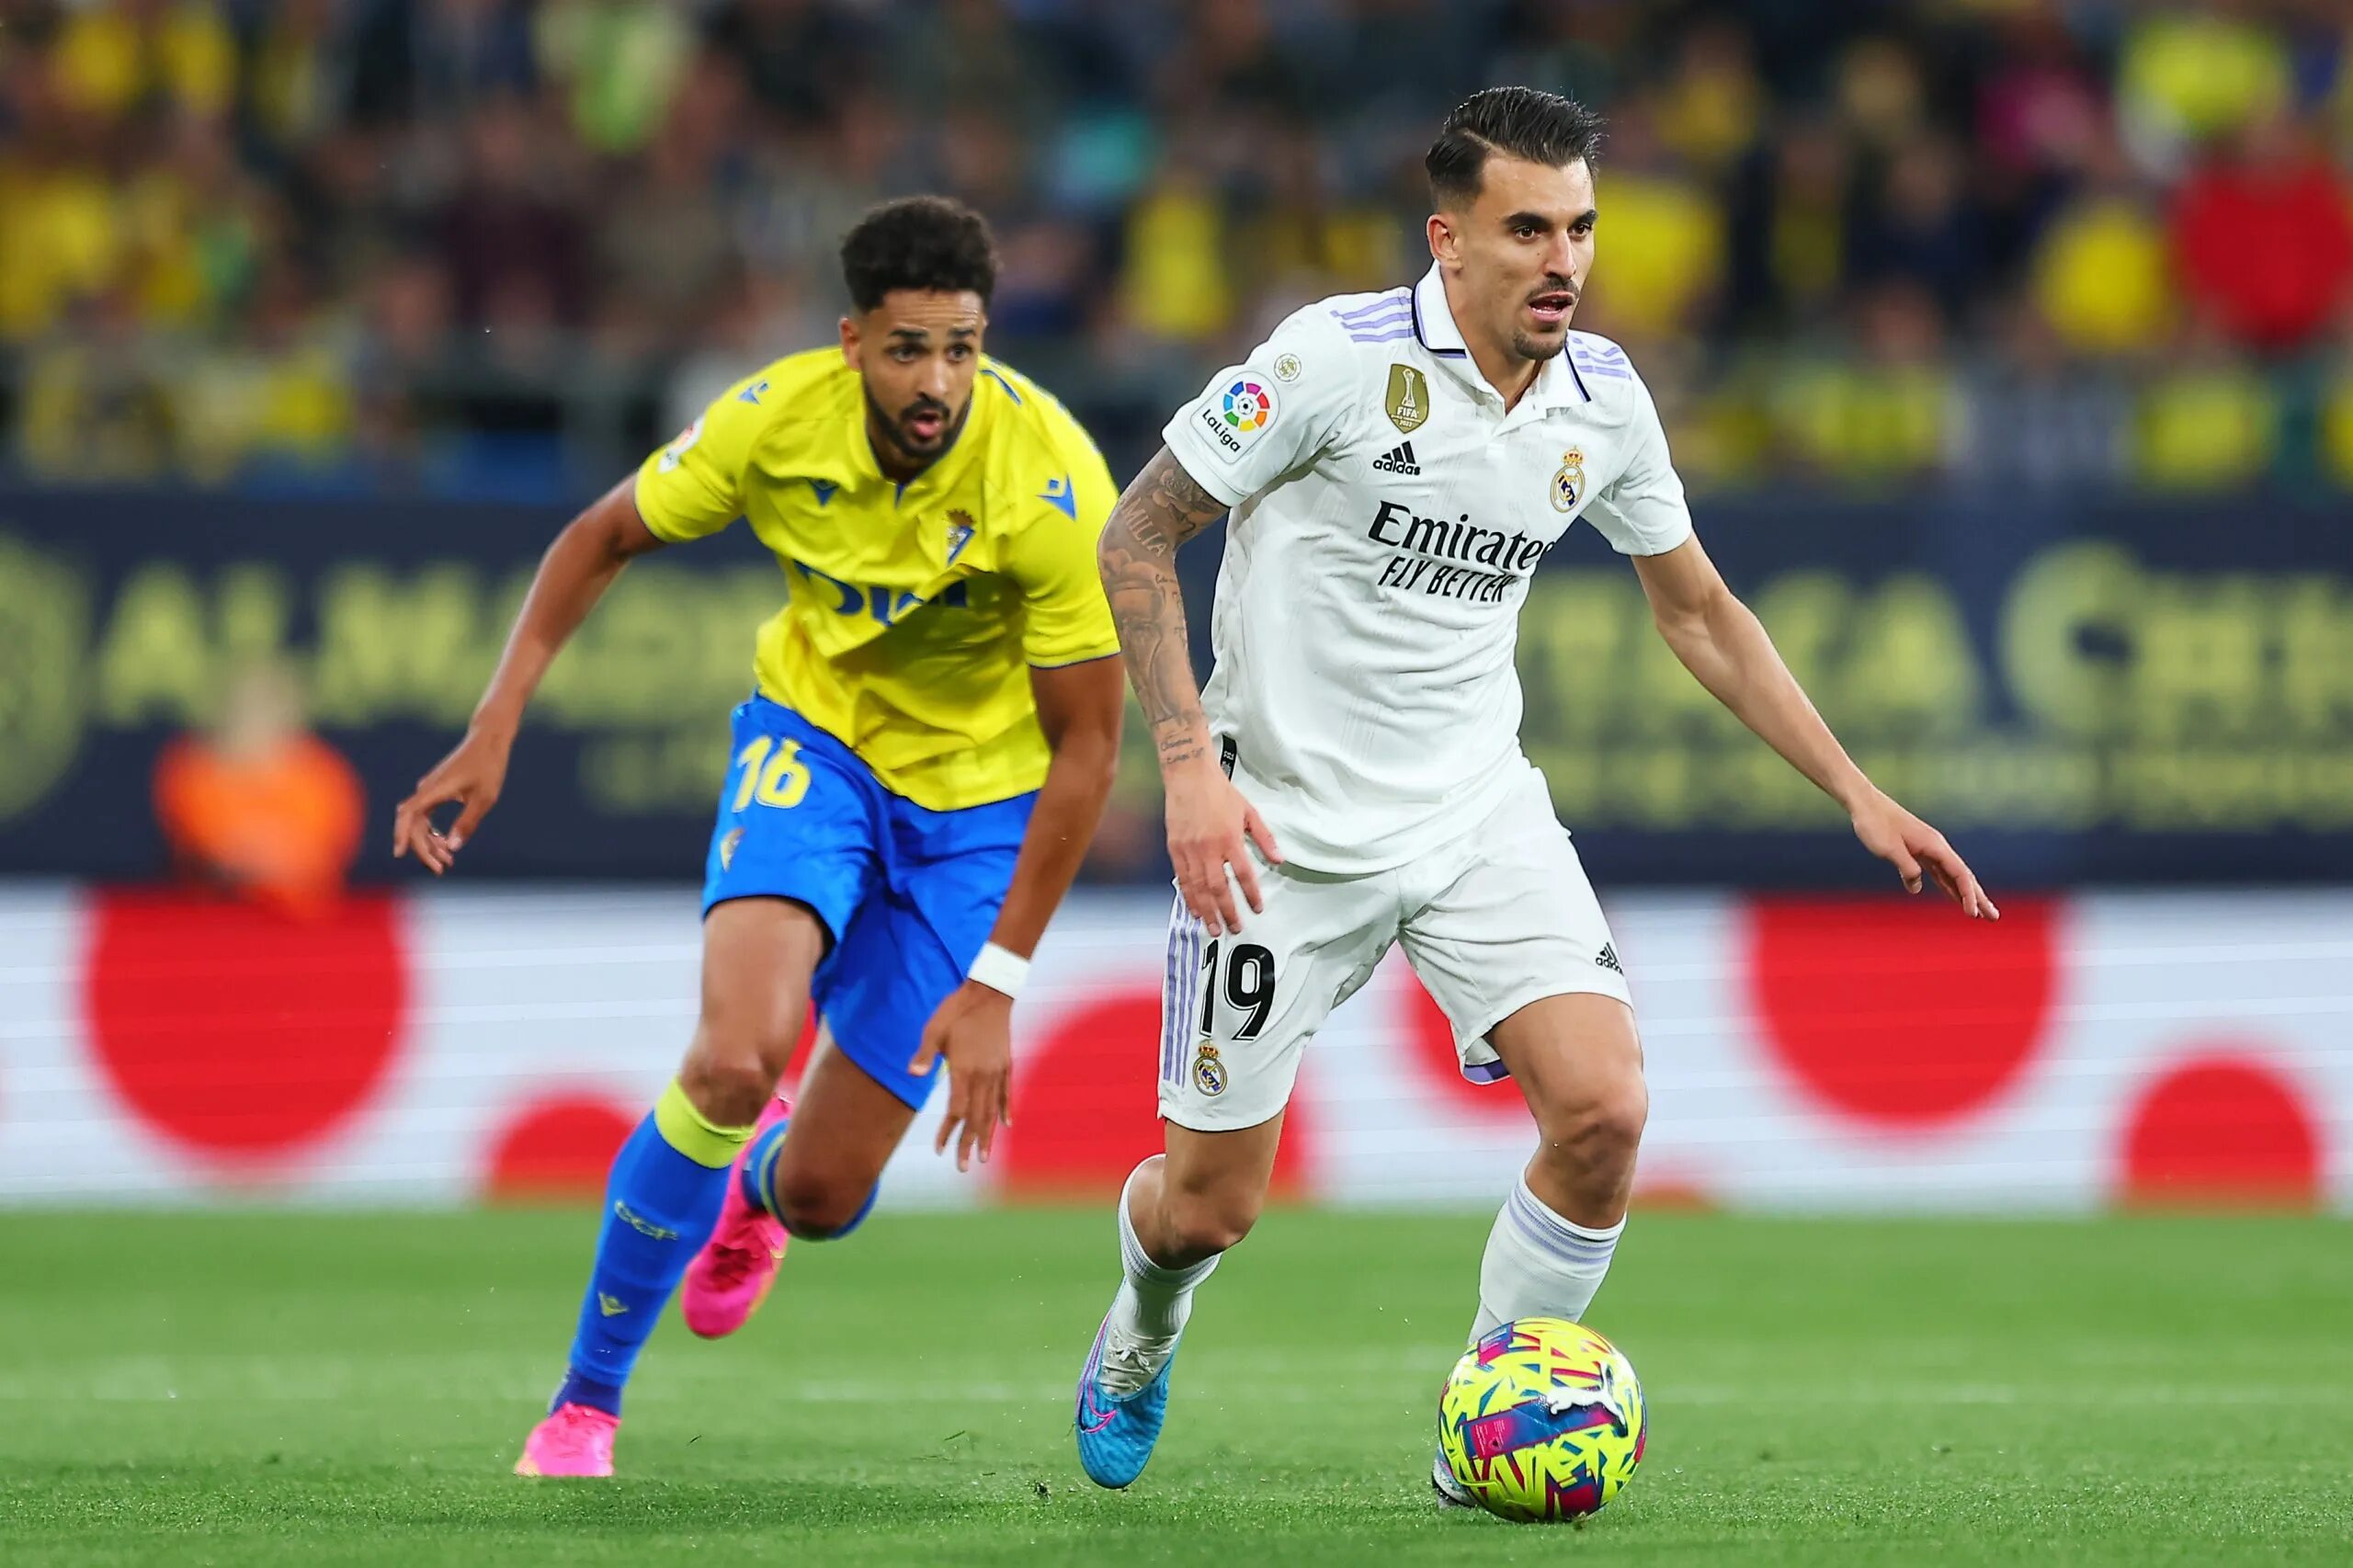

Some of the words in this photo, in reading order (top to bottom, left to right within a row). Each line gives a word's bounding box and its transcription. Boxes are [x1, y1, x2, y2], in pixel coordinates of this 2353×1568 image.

[1202, 408, 1241, 452] LaLiga
[1396, 405, 1417, 418] FIFA
[1372, 459, 1421, 476] adidas
[1377, 555, 1433, 590] FLY
[1426, 564, 1518, 602] BETTER
[732, 735, 812, 812] 16
[1595, 956, 1624, 976] adida
[1199, 938, 1276, 1041] 19
